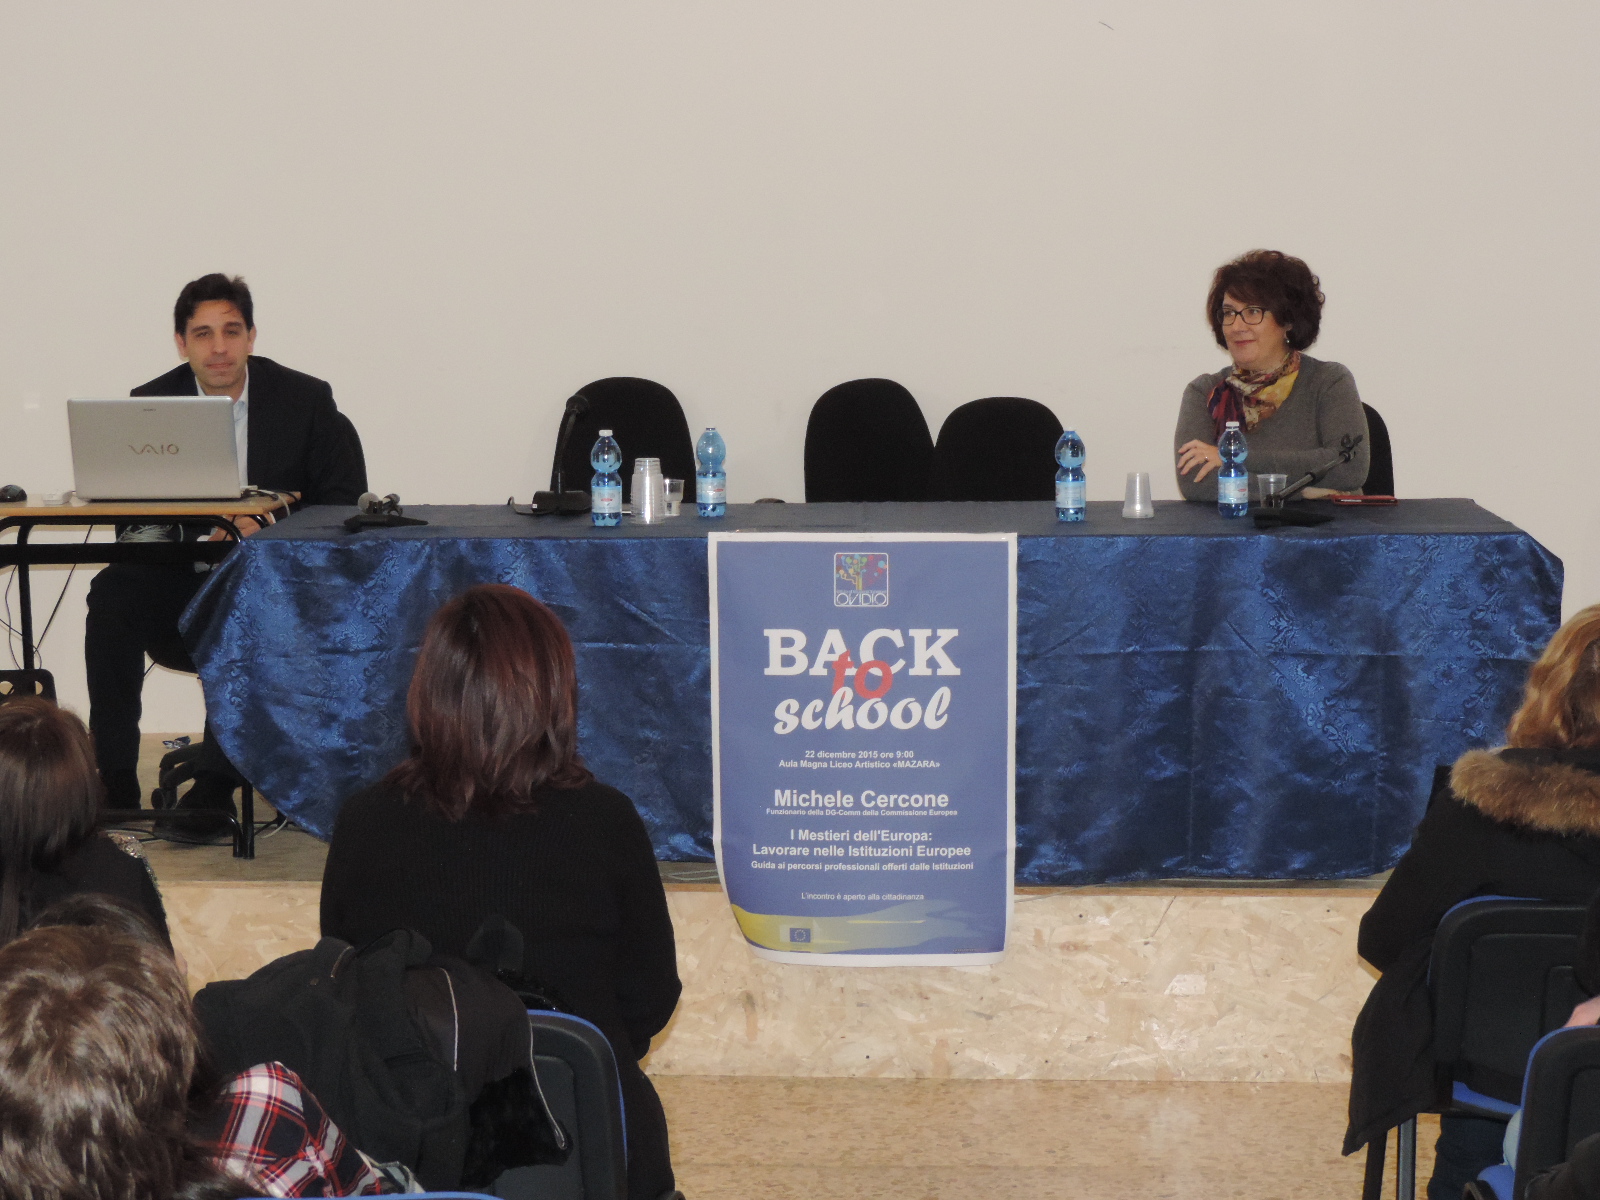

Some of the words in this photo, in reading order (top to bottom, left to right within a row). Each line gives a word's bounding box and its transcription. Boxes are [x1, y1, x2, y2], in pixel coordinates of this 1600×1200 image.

[128, 443, 180, 455] VAIO
[837, 593, 886, 605] OVIDIO
[763, 629, 960, 676] BACK
[832, 650, 893, 699] to
[774, 687, 951, 734] school
[800, 761, 827, 769] Magna
[775, 790, 854, 807] Michele
[861, 790, 948, 807] Cercone
[790, 829, 795, 840] I
[799, 830, 849, 840] Mestieri
[854, 830, 932, 843] dell'Europa:
[753, 844, 809, 855] Lavorare
[814, 846, 844, 856] nelle
[849, 846, 912, 856] Istituzioni
[917, 846, 971, 858] Europee
[751, 861, 775, 869] Guida
[777, 862, 786, 870] ai
[788, 862, 822, 871] percorsi
[825, 863, 879, 872] professionali
[882, 863, 907, 871] offerti
[933, 862, 973, 870] Istituzioni
[843, 893, 866, 902] aperto
